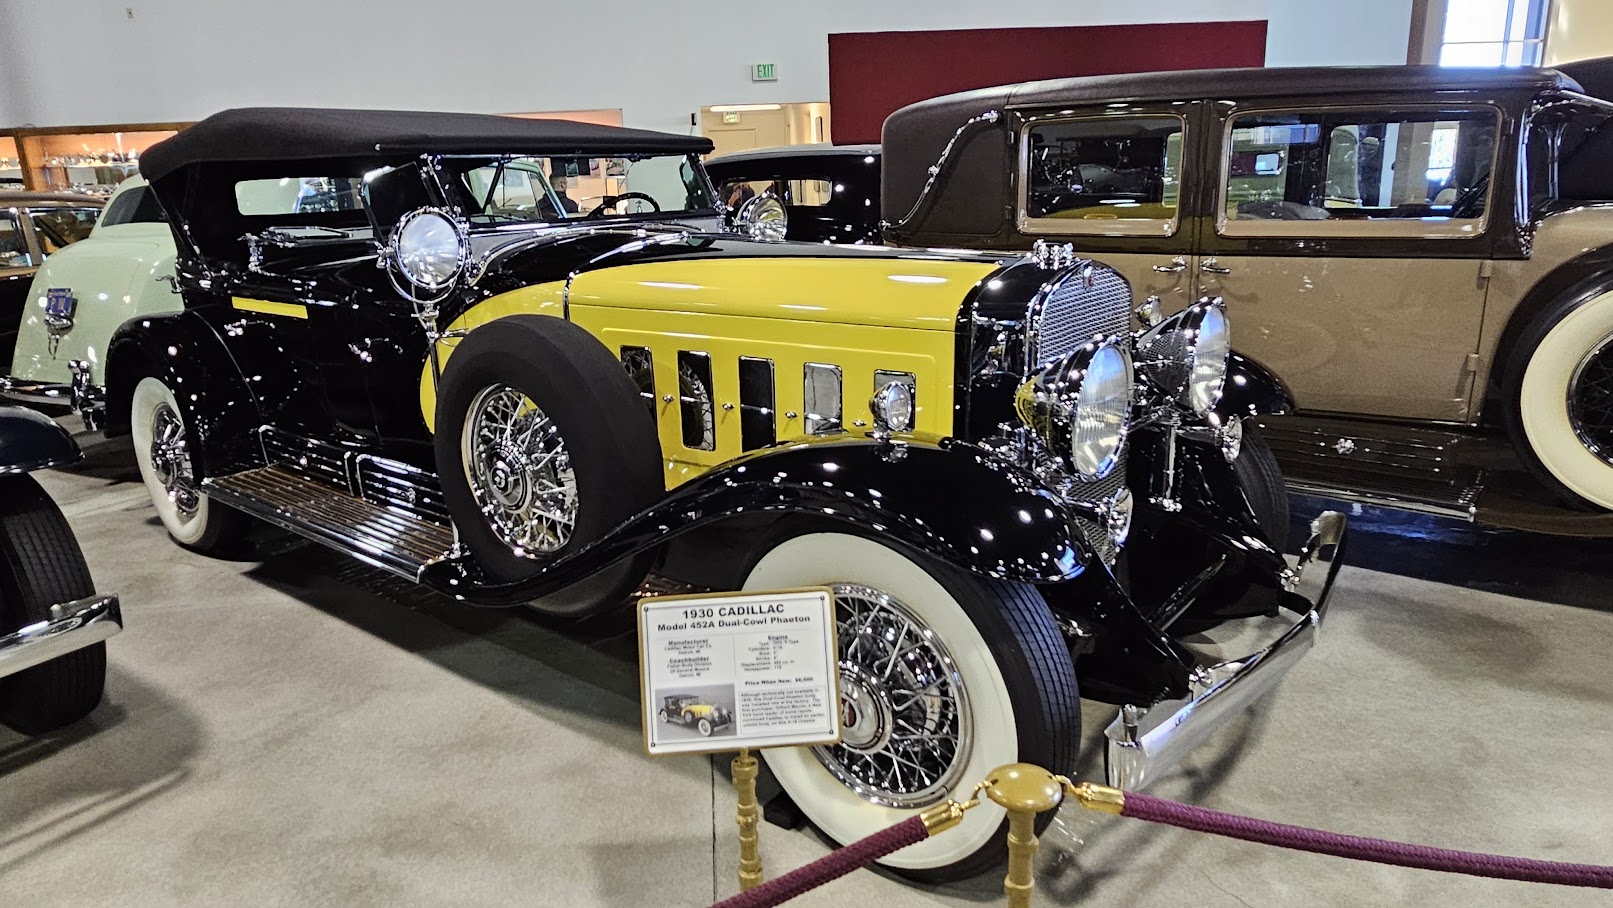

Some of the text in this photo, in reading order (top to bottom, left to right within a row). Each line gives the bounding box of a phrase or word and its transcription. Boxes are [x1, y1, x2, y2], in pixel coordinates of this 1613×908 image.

[757, 63, 774, 78] EXIT
[682, 603, 785, 619] 1930 CADILLAC
[657, 615, 811, 632] Model 452A Dual-Cowl Phaeton
[668, 638, 709, 646] Manufacturer
